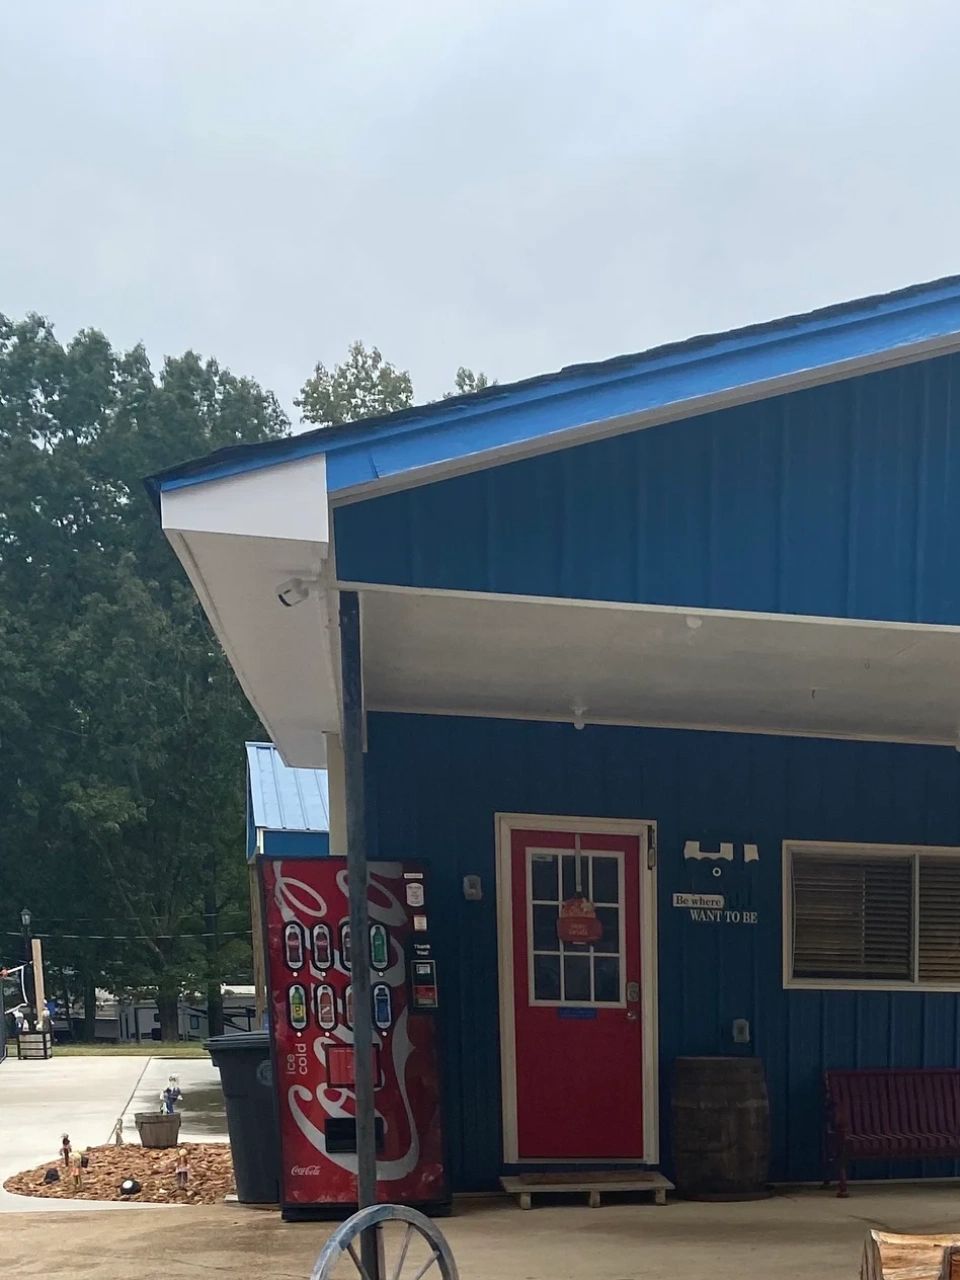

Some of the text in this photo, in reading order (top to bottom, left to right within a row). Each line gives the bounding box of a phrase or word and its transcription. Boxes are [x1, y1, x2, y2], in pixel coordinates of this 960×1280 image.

[675, 894, 721, 907] Be where
[690, 909, 758, 924] WANT TO BE
[295, 1043, 308, 1075] cold
